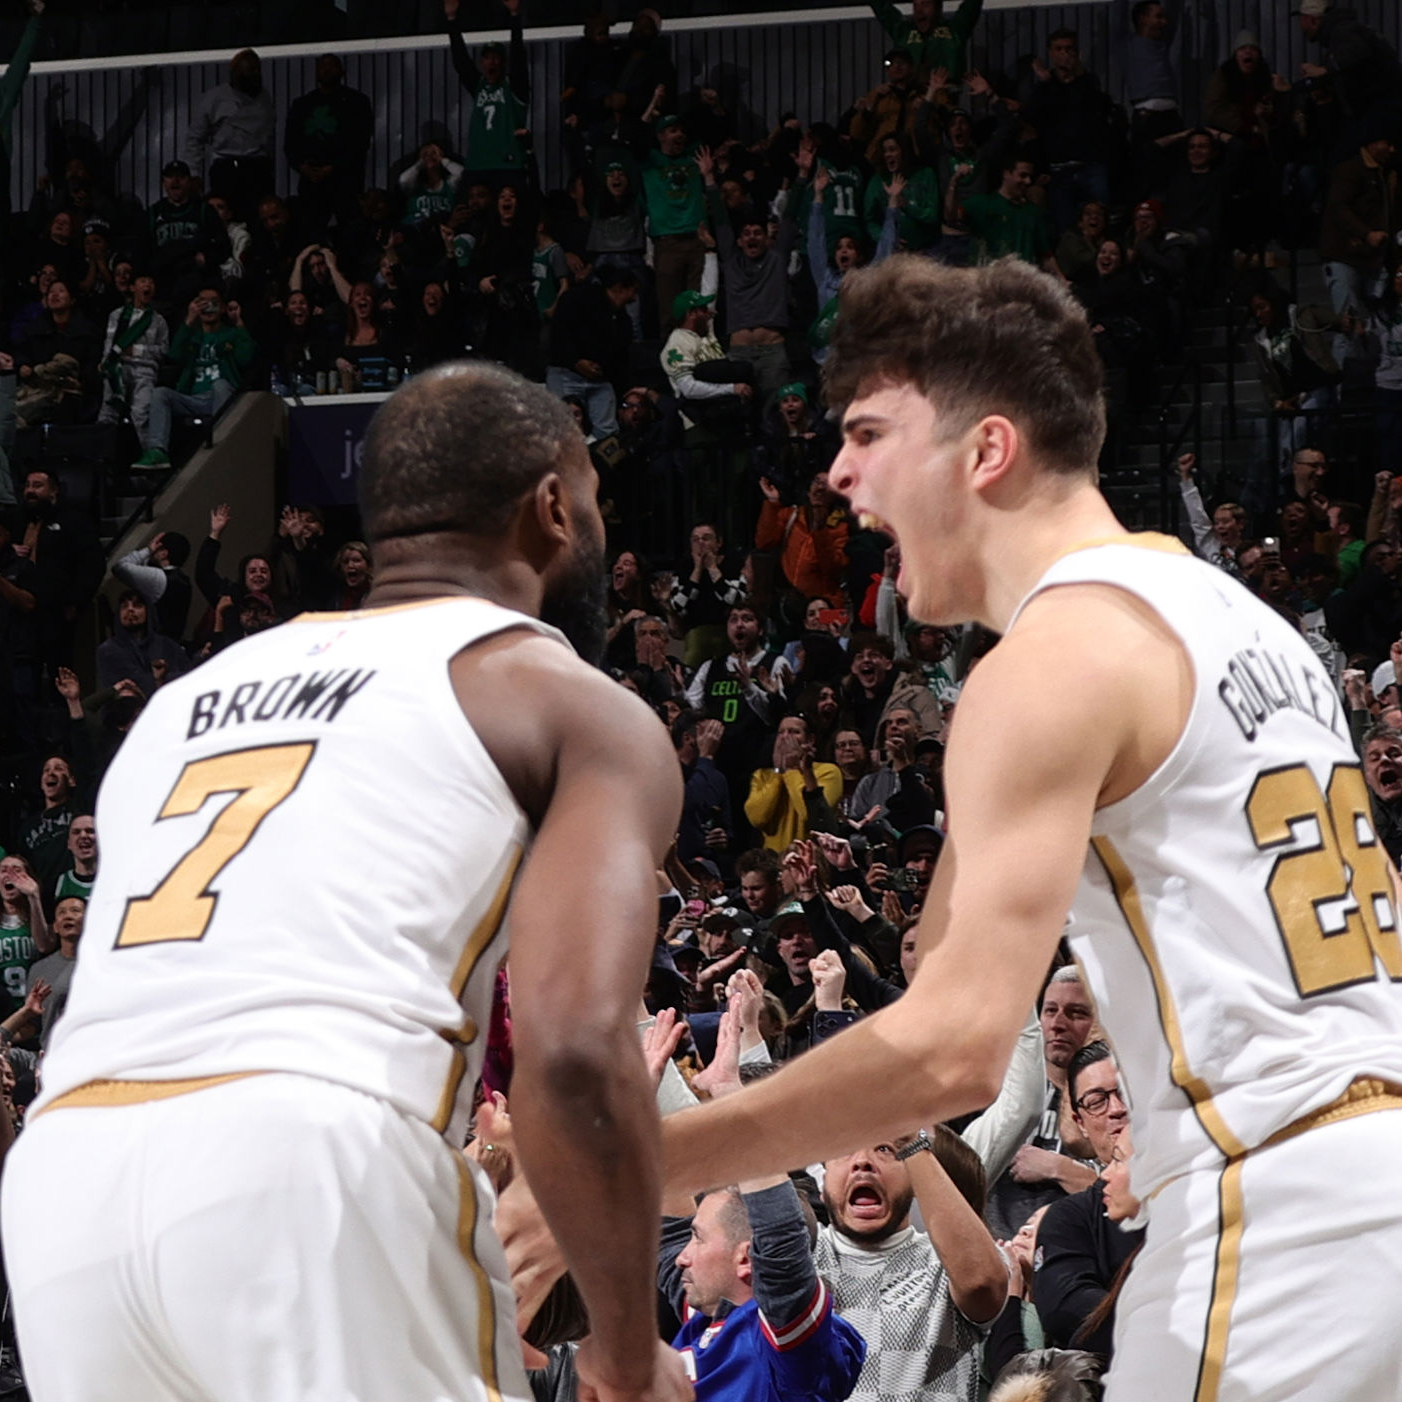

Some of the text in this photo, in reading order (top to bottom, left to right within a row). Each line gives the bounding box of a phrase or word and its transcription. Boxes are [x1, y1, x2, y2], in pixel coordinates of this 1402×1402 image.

[185, 669, 377, 742] BROWN
[723, 698, 739, 723] 0
[112, 739, 320, 950] 7
[3, 965, 28, 998] 9
